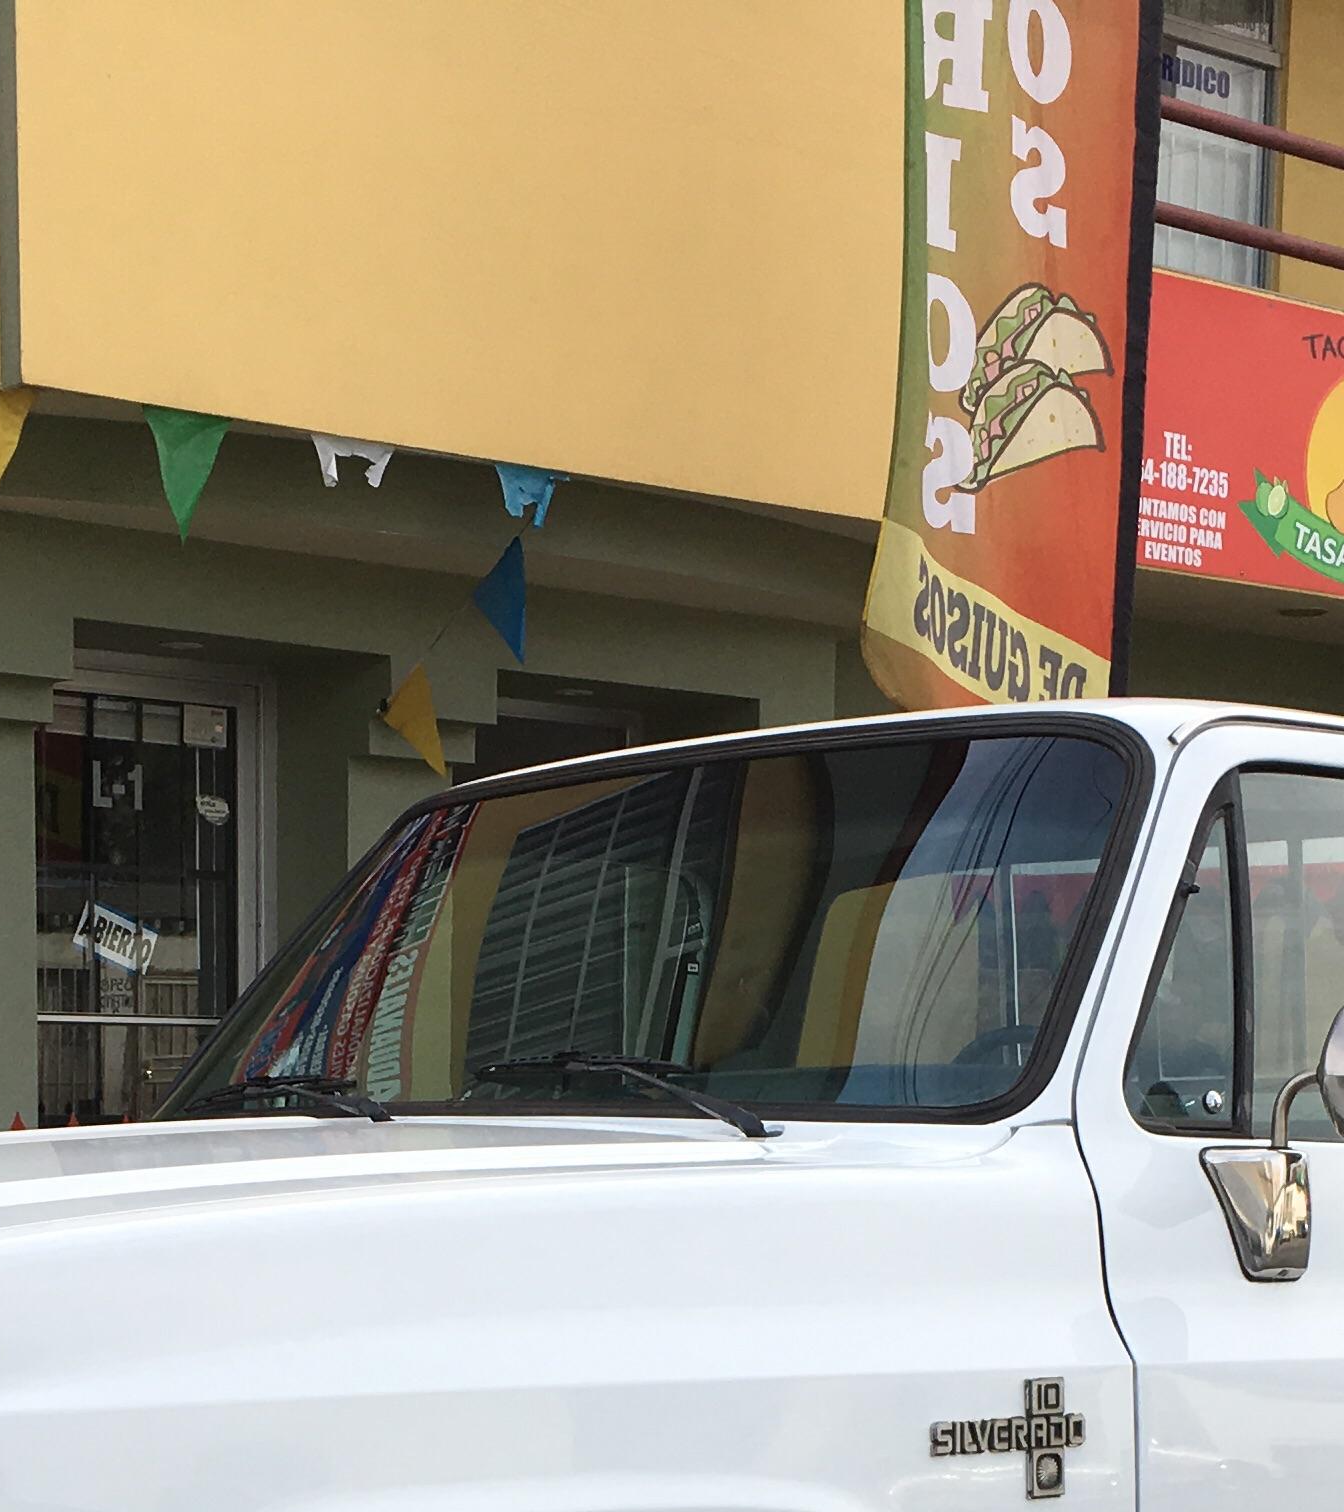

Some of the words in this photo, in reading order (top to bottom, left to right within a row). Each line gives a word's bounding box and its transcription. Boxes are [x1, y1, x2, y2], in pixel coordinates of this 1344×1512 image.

[1163, 431, 1193, 462] TEL:
[1199, 508, 1227, 529] CON
[1189, 527, 1223, 550] PARA
[1144, 541, 1202, 567] EVENTOS
[1036, 1383, 1061, 1411] 10
[929, 1412, 1087, 1458] SILVERADO
